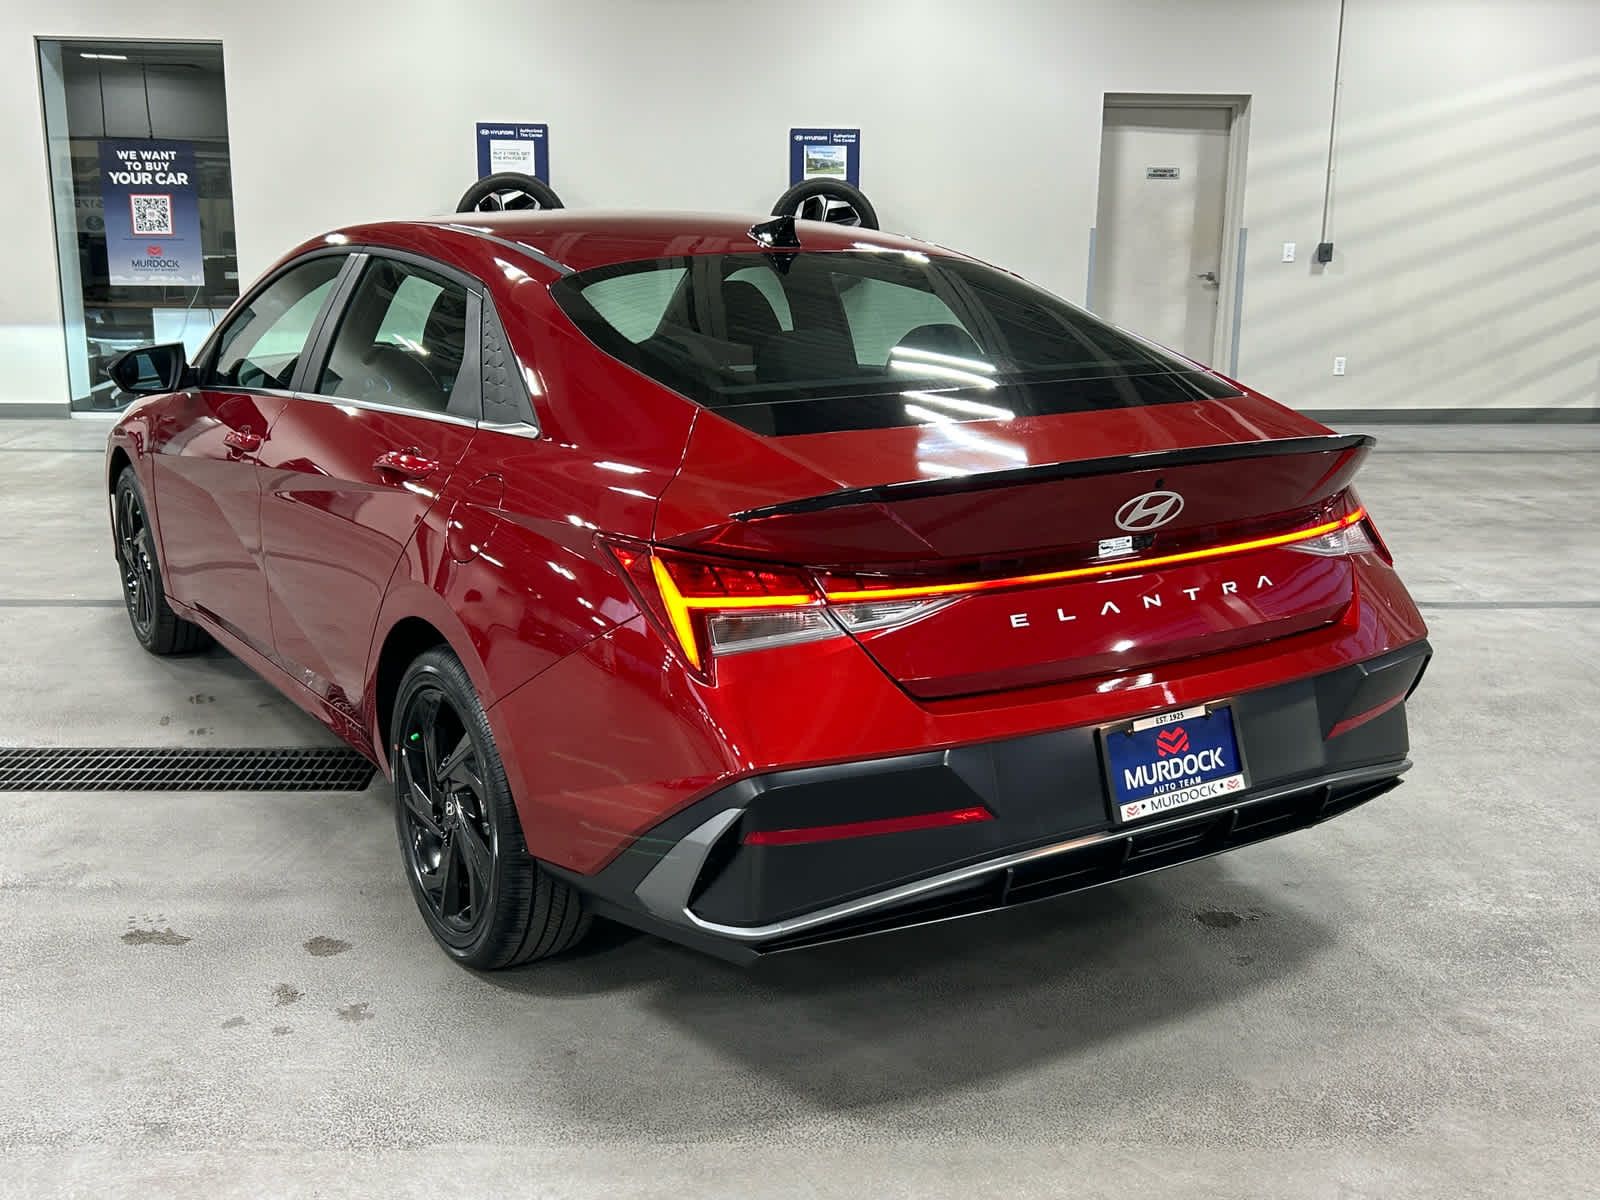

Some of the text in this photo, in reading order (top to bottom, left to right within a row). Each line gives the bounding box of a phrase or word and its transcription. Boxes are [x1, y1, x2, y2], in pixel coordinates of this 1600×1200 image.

[116, 150, 177, 160] WE WANT
[125, 161, 170, 171] TO BUY
[108, 171, 189, 185] YOUR CAR
[131, 259, 180, 268] MURDOCK
[1009, 575, 1273, 628] ELANTRA
[1156, 711, 1185, 724] EST. 1925
[1124, 747, 1225, 790] MURDOCK
[1153, 775, 1202, 795] AUTO TEAM
[1150, 783, 1218, 811] MURDOCK
